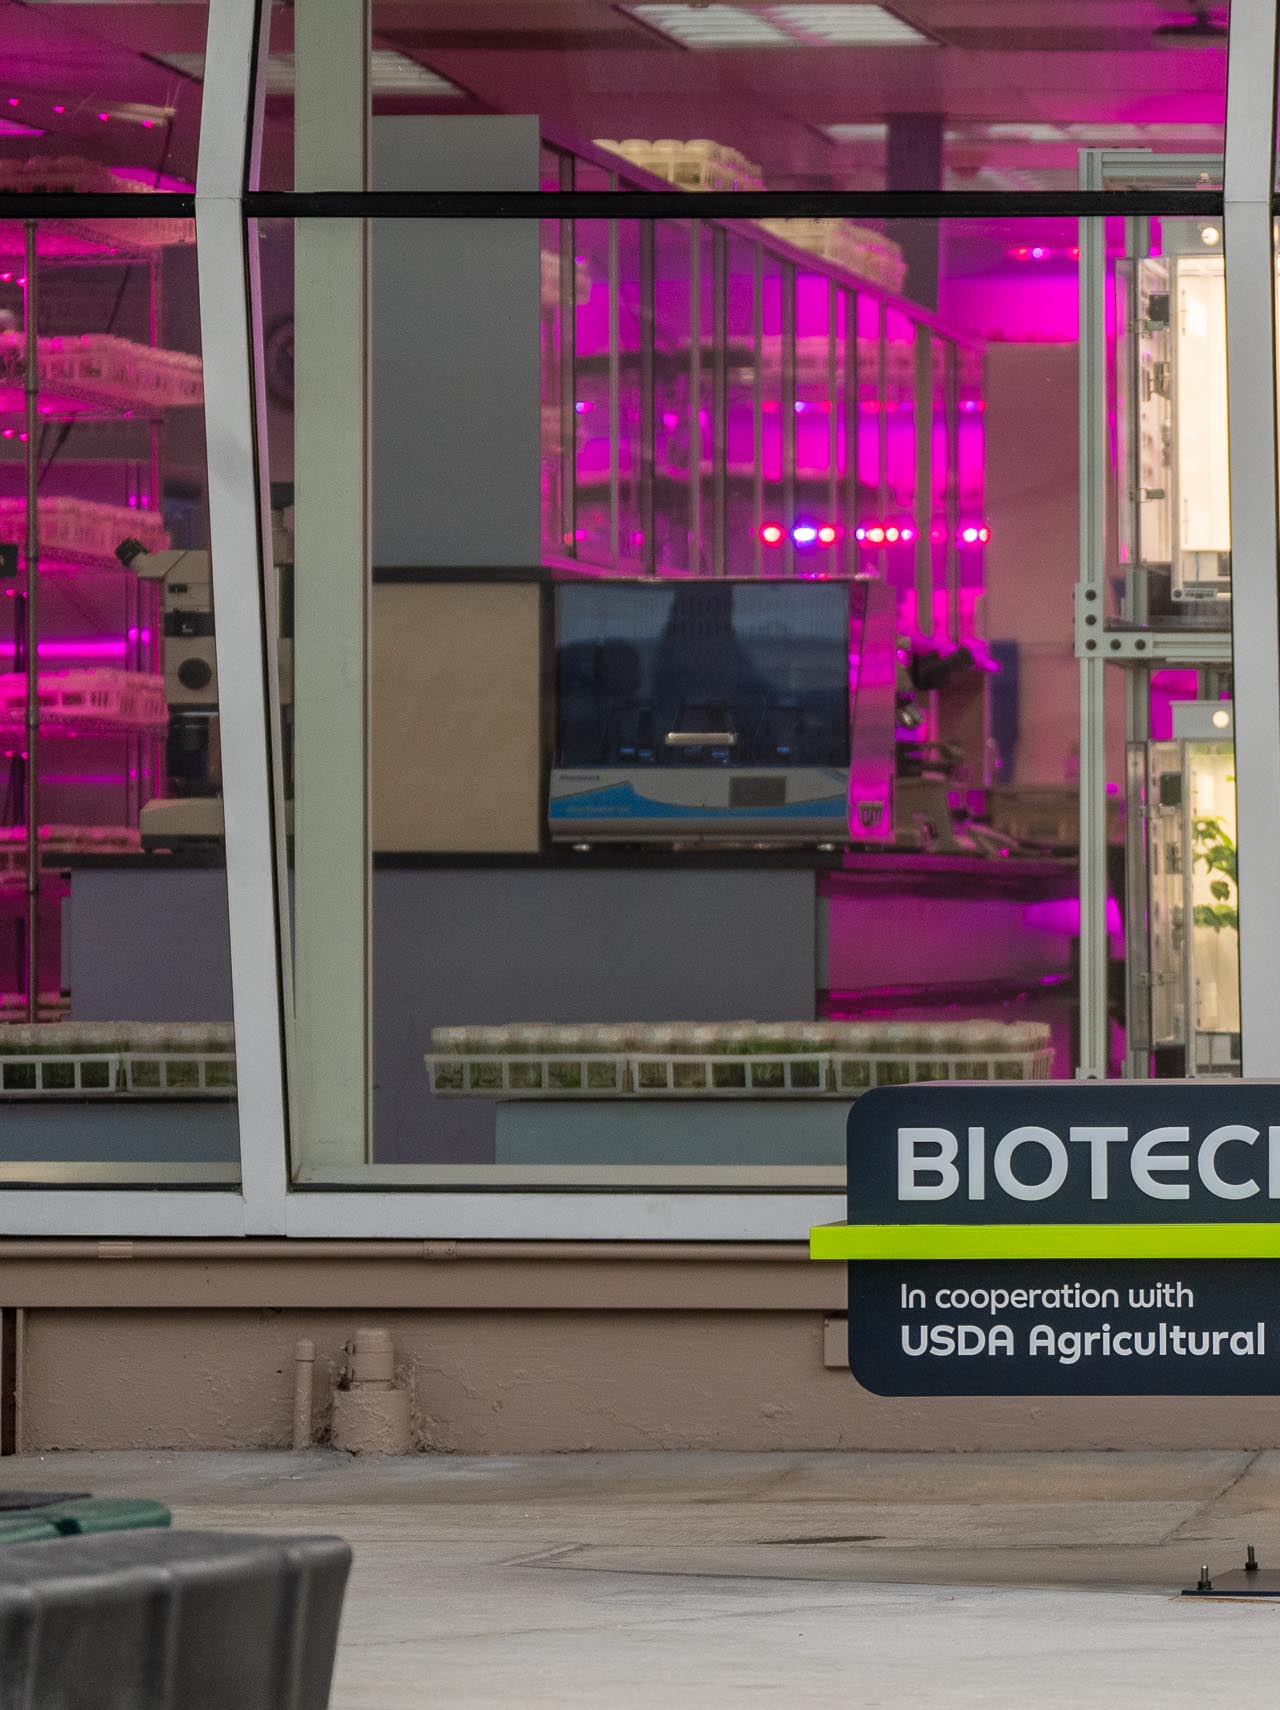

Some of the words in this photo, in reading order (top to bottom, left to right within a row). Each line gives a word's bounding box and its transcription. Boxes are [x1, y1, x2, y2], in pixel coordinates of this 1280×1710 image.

[901, 1284, 926, 1309] In
[935, 1283, 1119, 1316] cooperation
[1128, 1281, 1194, 1309] with
[901, 1324, 1015, 1357] USDA
[1029, 1322, 1265, 1365] Agricultural
